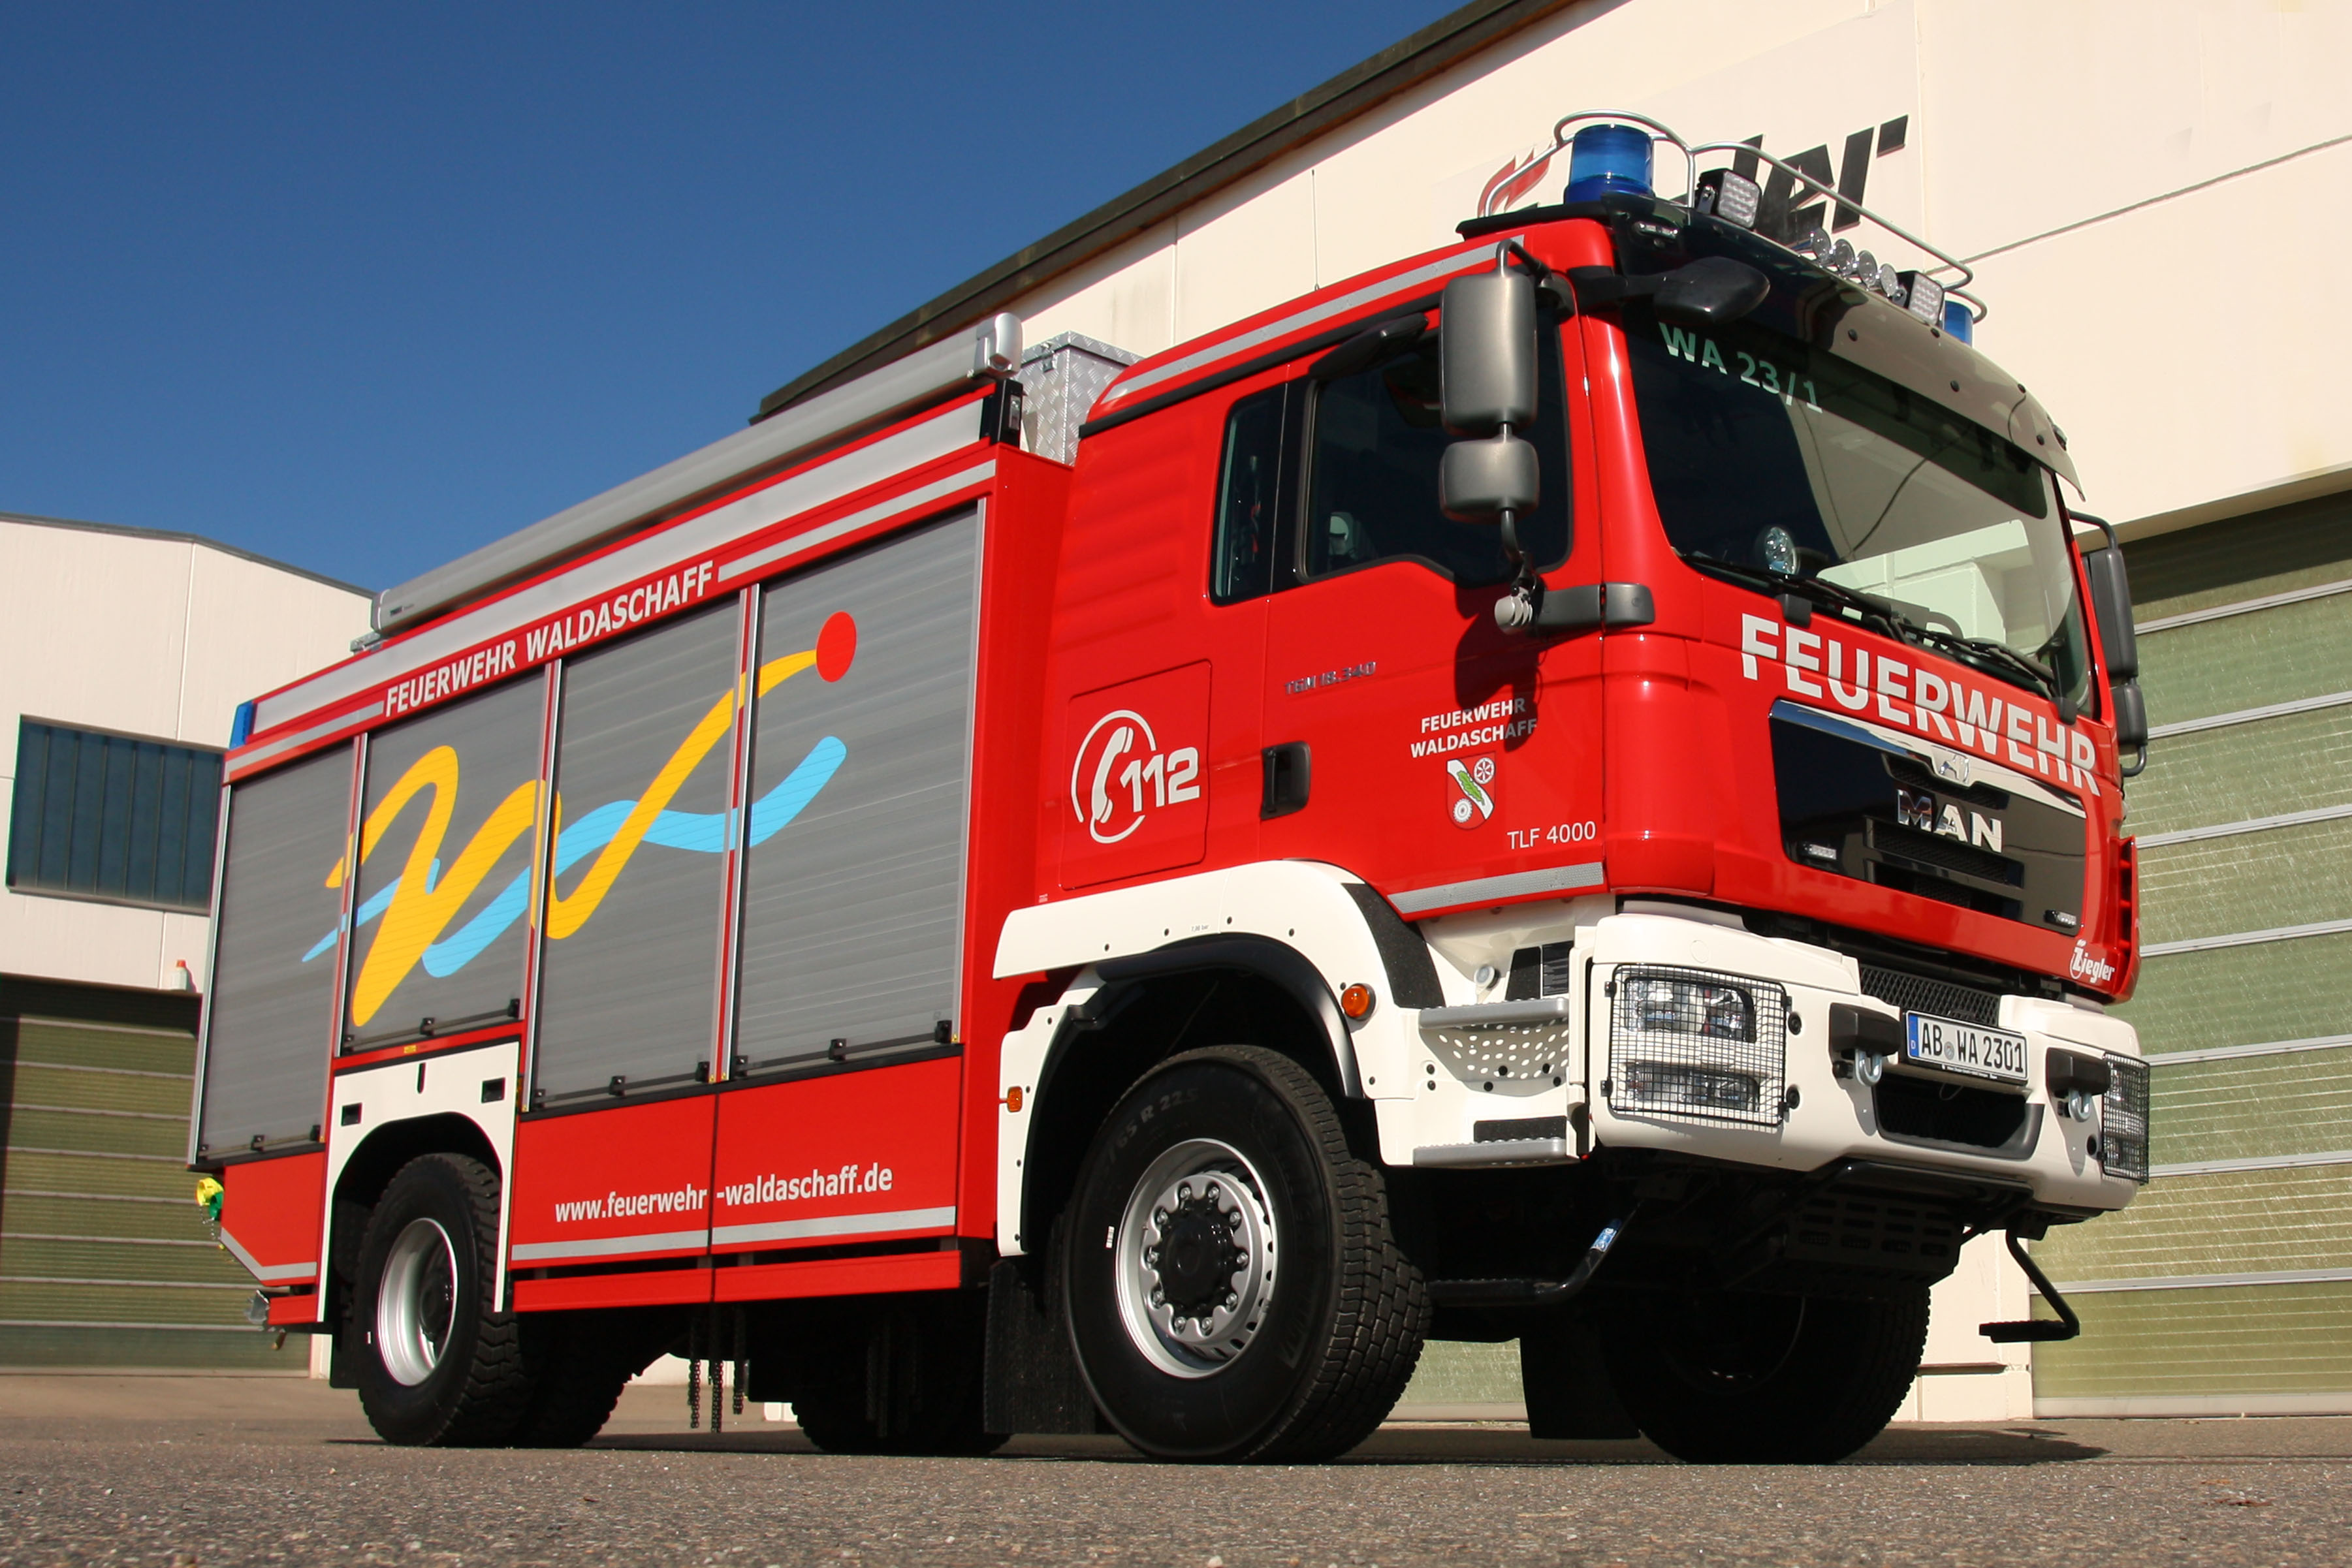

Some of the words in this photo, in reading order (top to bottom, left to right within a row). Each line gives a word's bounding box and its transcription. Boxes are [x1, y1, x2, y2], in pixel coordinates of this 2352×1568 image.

[1659, 322, 1728, 375] WA
[1737, 352, 1823, 413] 23/1
[386, 640, 517, 717] FEUERWEHR
[526, 560, 714, 663] WALDASCHAFF
[1421, 698, 1526, 734] FEUERWEHR
[1741, 613, 2101, 796] FEUERWEHR
[1410, 718, 1537, 758] WALDASCHAFF
[1120, 746, 1200, 813] 112
[1507, 828, 1540, 849] TLF
[1546, 821, 1596, 845] 4000
[1898, 789, 2002, 853] MAN
[2069, 939, 2116, 984] Ziegler
[1922, 1023, 1943, 1056] AB
[1957, 1029, 1979, 1064] WA
[1983, 1035, 2024, 1073] 2301
